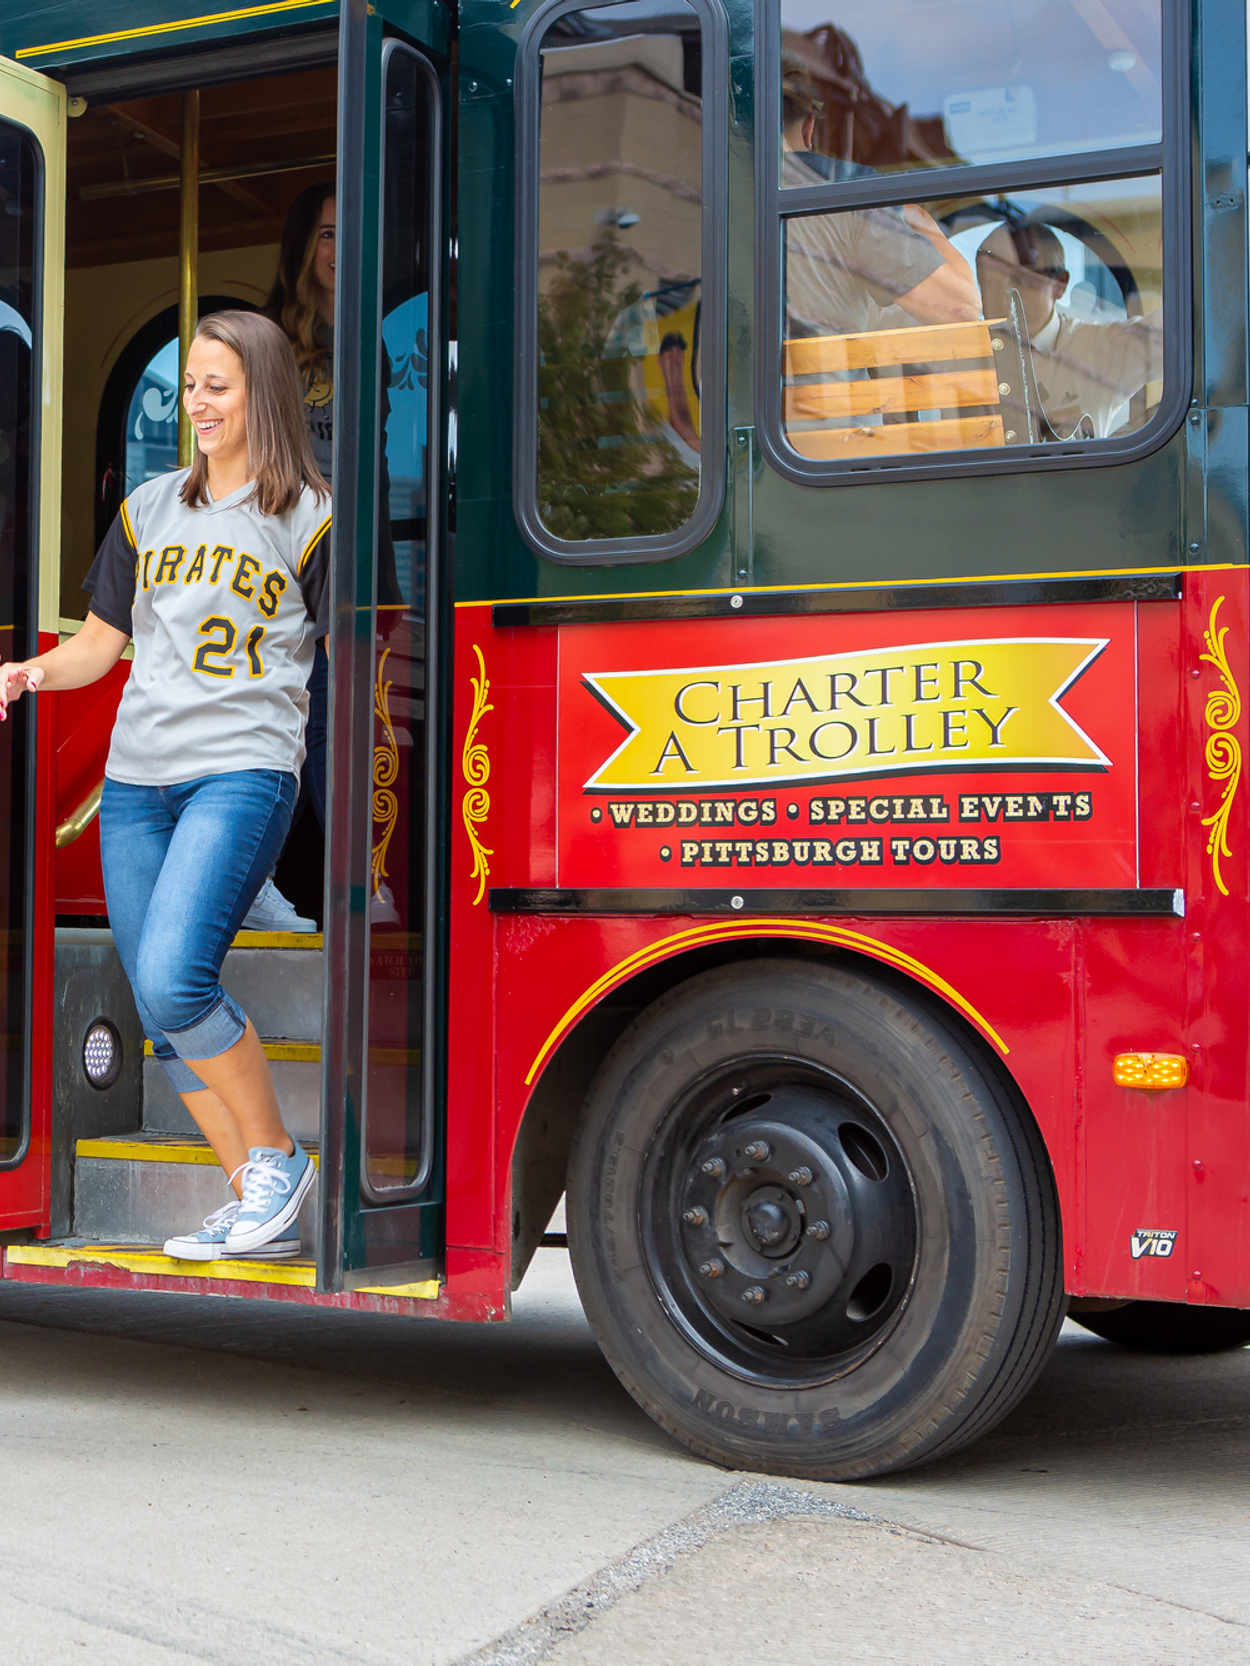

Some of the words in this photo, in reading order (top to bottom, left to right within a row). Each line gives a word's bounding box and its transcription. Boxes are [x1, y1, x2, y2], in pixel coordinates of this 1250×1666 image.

[191, 614, 266, 678] 21
[673, 658, 1000, 727] CHARTER
[649, 729, 700, 774] A
[716, 706, 1021, 769] TROLLEY
[608, 799, 777, 825] WEDDINGS
[808, 797, 950, 821] SPECIAL
[680, 839, 882, 864] PITTSBURGH
[891, 838, 1000, 862] TOURS
[1130, 1236, 1174, 1259] V10
[1137, 1231, 1176, 1239] TRITON
[689, 1385, 844, 1436] SAMSON
